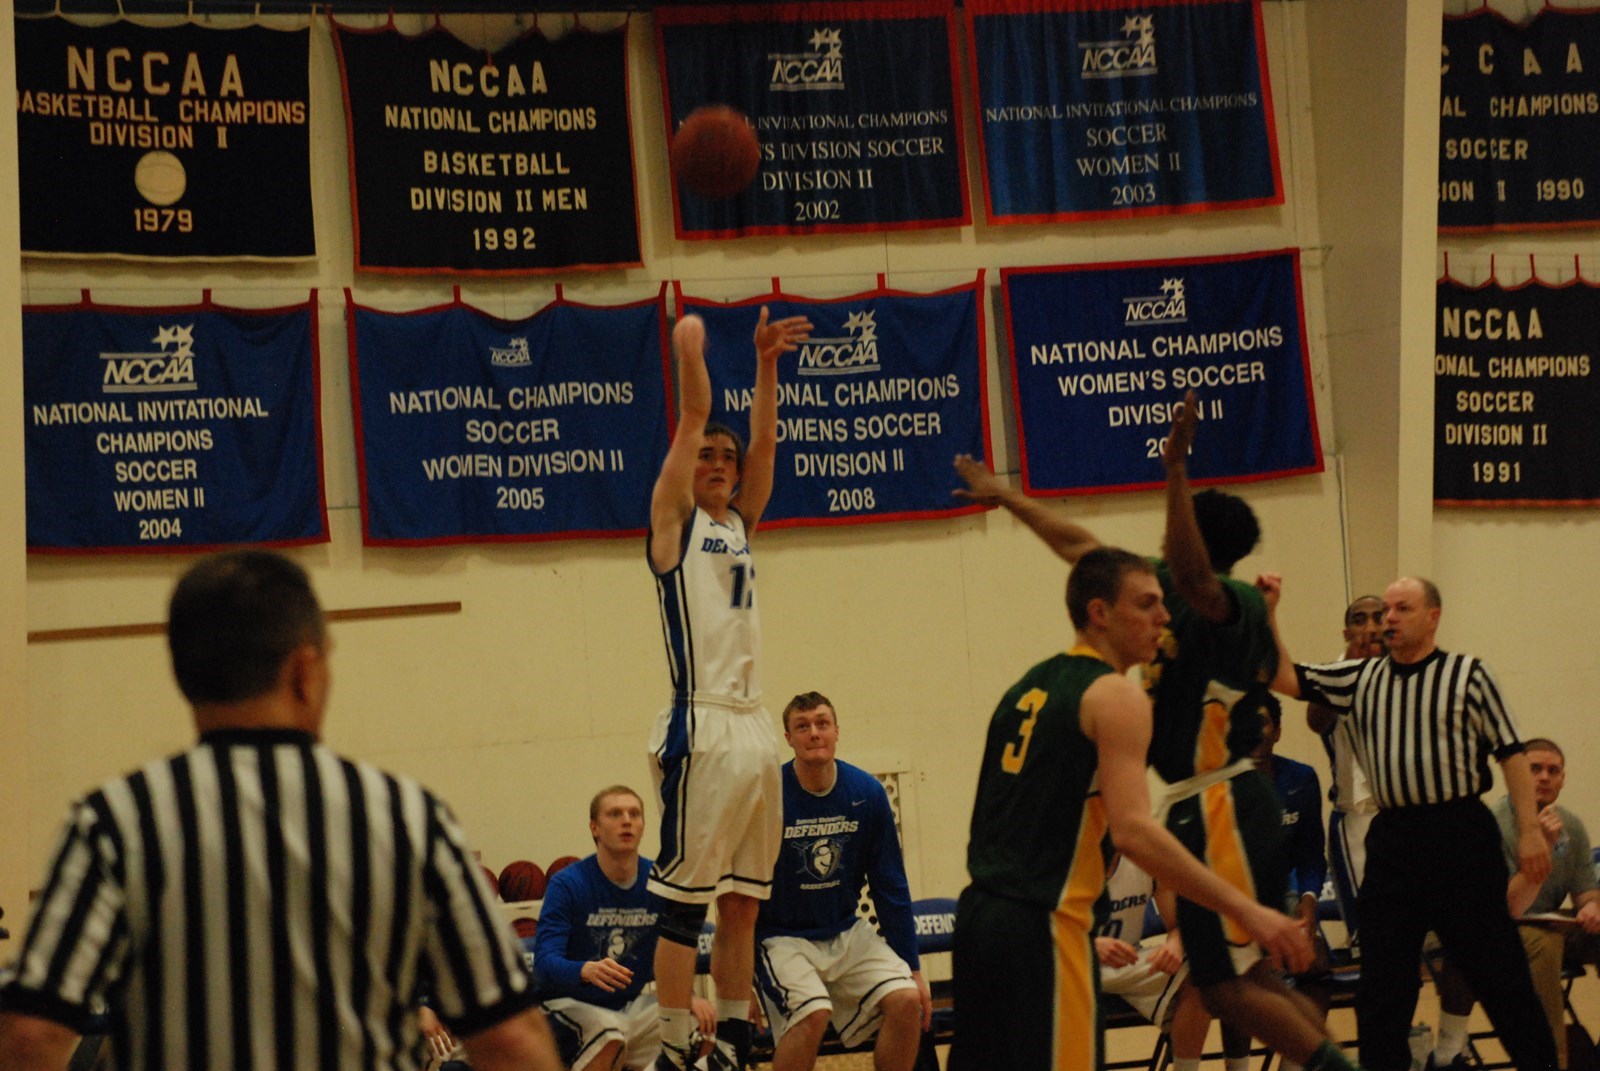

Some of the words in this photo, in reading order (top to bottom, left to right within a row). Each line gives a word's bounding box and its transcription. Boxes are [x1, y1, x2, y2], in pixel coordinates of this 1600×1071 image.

[1082, 45, 1157, 71] NCCAA
[67, 45, 244, 98] NCCAA
[429, 59, 548, 97] NCCAA
[771, 59, 842, 83] NCCAA
[17, 90, 159, 122] ASKETBALL
[179, 100, 305, 125] CHAMPIONS
[986, 104, 1063, 123] NATIONAL
[1066, 98, 1168, 119] INVITATIONAL
[1170, 92, 1257, 112] CHAMPIONS
[1490, 92, 1599, 118] CHAMPIONS
[385, 105, 481, 133] NATIONAL
[488, 107, 597, 133] CHAMPIONS
[758, 113, 853, 131] INVITATIONAL
[858, 109, 948, 127] CHAMPIONS
[90, 122, 193, 149] DIVISION
[1086, 123, 1167, 147] SOCCER
[781, 141, 861, 161] DIVISION
[867, 136, 944, 158] SOCCER
[1445, 138, 1529, 161] SOCCER
[424, 150, 570, 176] BASKETBALL
[1076, 153, 1159, 177] WOMEN
[1169, 152, 1181, 172] II
[763, 170, 851, 191] DIVISION
[858, 169, 873, 190] II
[1438, 180, 1474, 201] ION
[1536, 177, 1585, 201] 1990
[410, 187, 502, 213] DIVISION
[516, 188, 533, 212] II
[542, 187, 588, 211] MEN
[1111, 183, 1156, 205] 2003
[134, 208, 193, 232] 1979
[795, 200, 840, 221] 2002
[473, 227, 536, 251] 1992
[1126, 300, 1186, 321] NCCAA
[1443, 307, 1543, 341] NCCAA
[799, 340, 879, 367] NCCAA
[1031, 338, 1146, 365] NATIONAL
[1152, 325, 1283, 358] CHAMPIONS
[103, 358, 194, 384] NCCAA
[1058, 369, 1166, 397] WOMEN'S
[1172, 361, 1265, 389] SOCCER
[1488, 355, 1591, 379] CHAMPIONS
[389, 386, 502, 415] NATIONAL
[508, 381, 634, 410] CHAMPIONS
[834, 373, 960, 407] CHAMPIONS
[1456, 390, 1535, 413] SOCCER
[33, 402, 133, 426] NATIONAL
[138, 396, 269, 422] INVITATIONAL
[1211, 399, 1223, 420] II
[466, 418, 560, 445] SOCCER
[776, 418, 848, 443] OMENS
[853, 412, 941, 442] SOCCER
[1445, 423, 1523, 446] DIVISION
[1532, 424, 1547, 446] II
[96, 429, 214, 454] CHAMPIONS
[116, 458, 198, 483] SOCCER
[422, 454, 502, 481] WOMEN
[508, 449, 605, 478] DIVISION
[610, 449, 624, 472] II
[794, 450, 886, 478] DIVISION
[892, 448, 904, 472] II
[1473, 461, 1521, 483] 1991
[113, 488, 189, 512] WOMEN
[194, 487, 205, 508] II
[496, 487, 545, 510] 2005
[827, 487, 876, 512] 2008
[139, 518, 182, 540] 2004
[1001, 687, 1048, 775] 3
[783, 820, 859, 838] DEFENDERS
